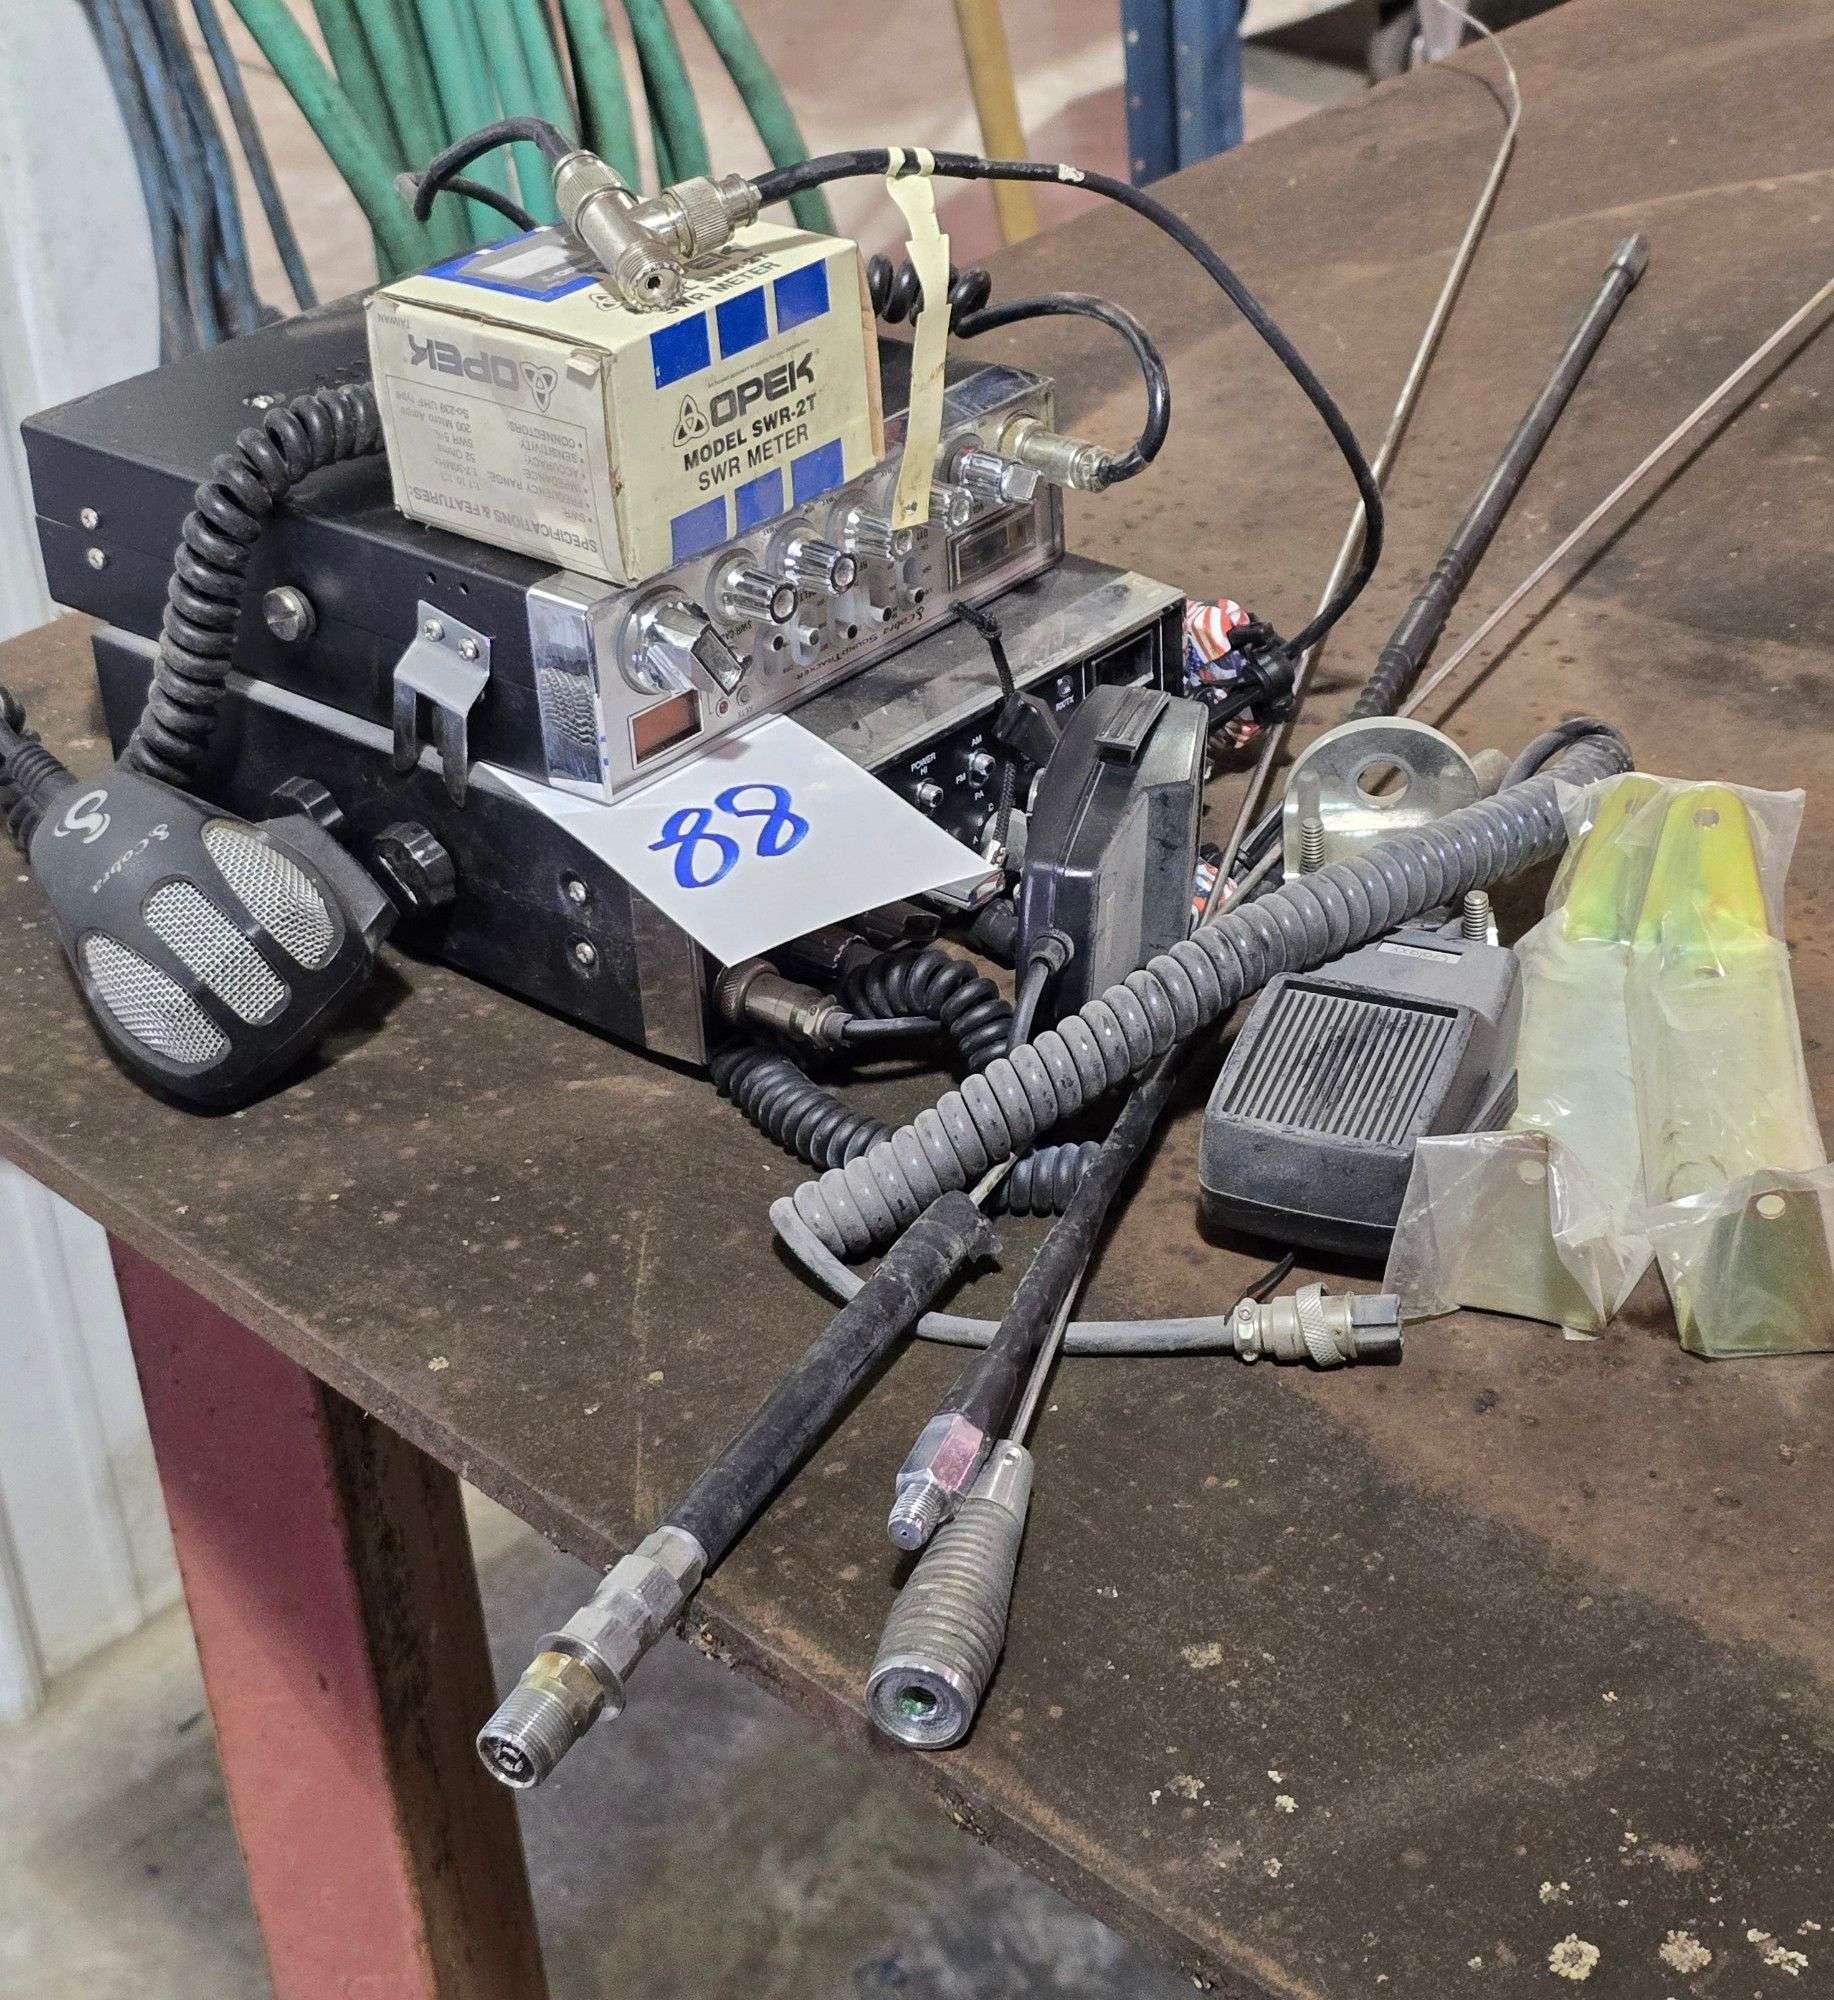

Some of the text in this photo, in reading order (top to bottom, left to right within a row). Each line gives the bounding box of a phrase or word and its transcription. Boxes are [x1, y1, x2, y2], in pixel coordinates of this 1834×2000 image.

[710, 261, 781, 293] METER
[377, 312, 410, 330] TAIWAN
[408, 334, 519, 391] OPEK
[709, 351, 815, 428] OPEK
[684, 393, 817, 472] MODEL SWR-2T
[698, 423, 809, 491] SWR METER
[482, 506, 493, 518] &
[494, 509, 598, 553] SPECIFICATIONS
[910, 752, 937, 773] POWER
[649, 784, 809, 889] 88
